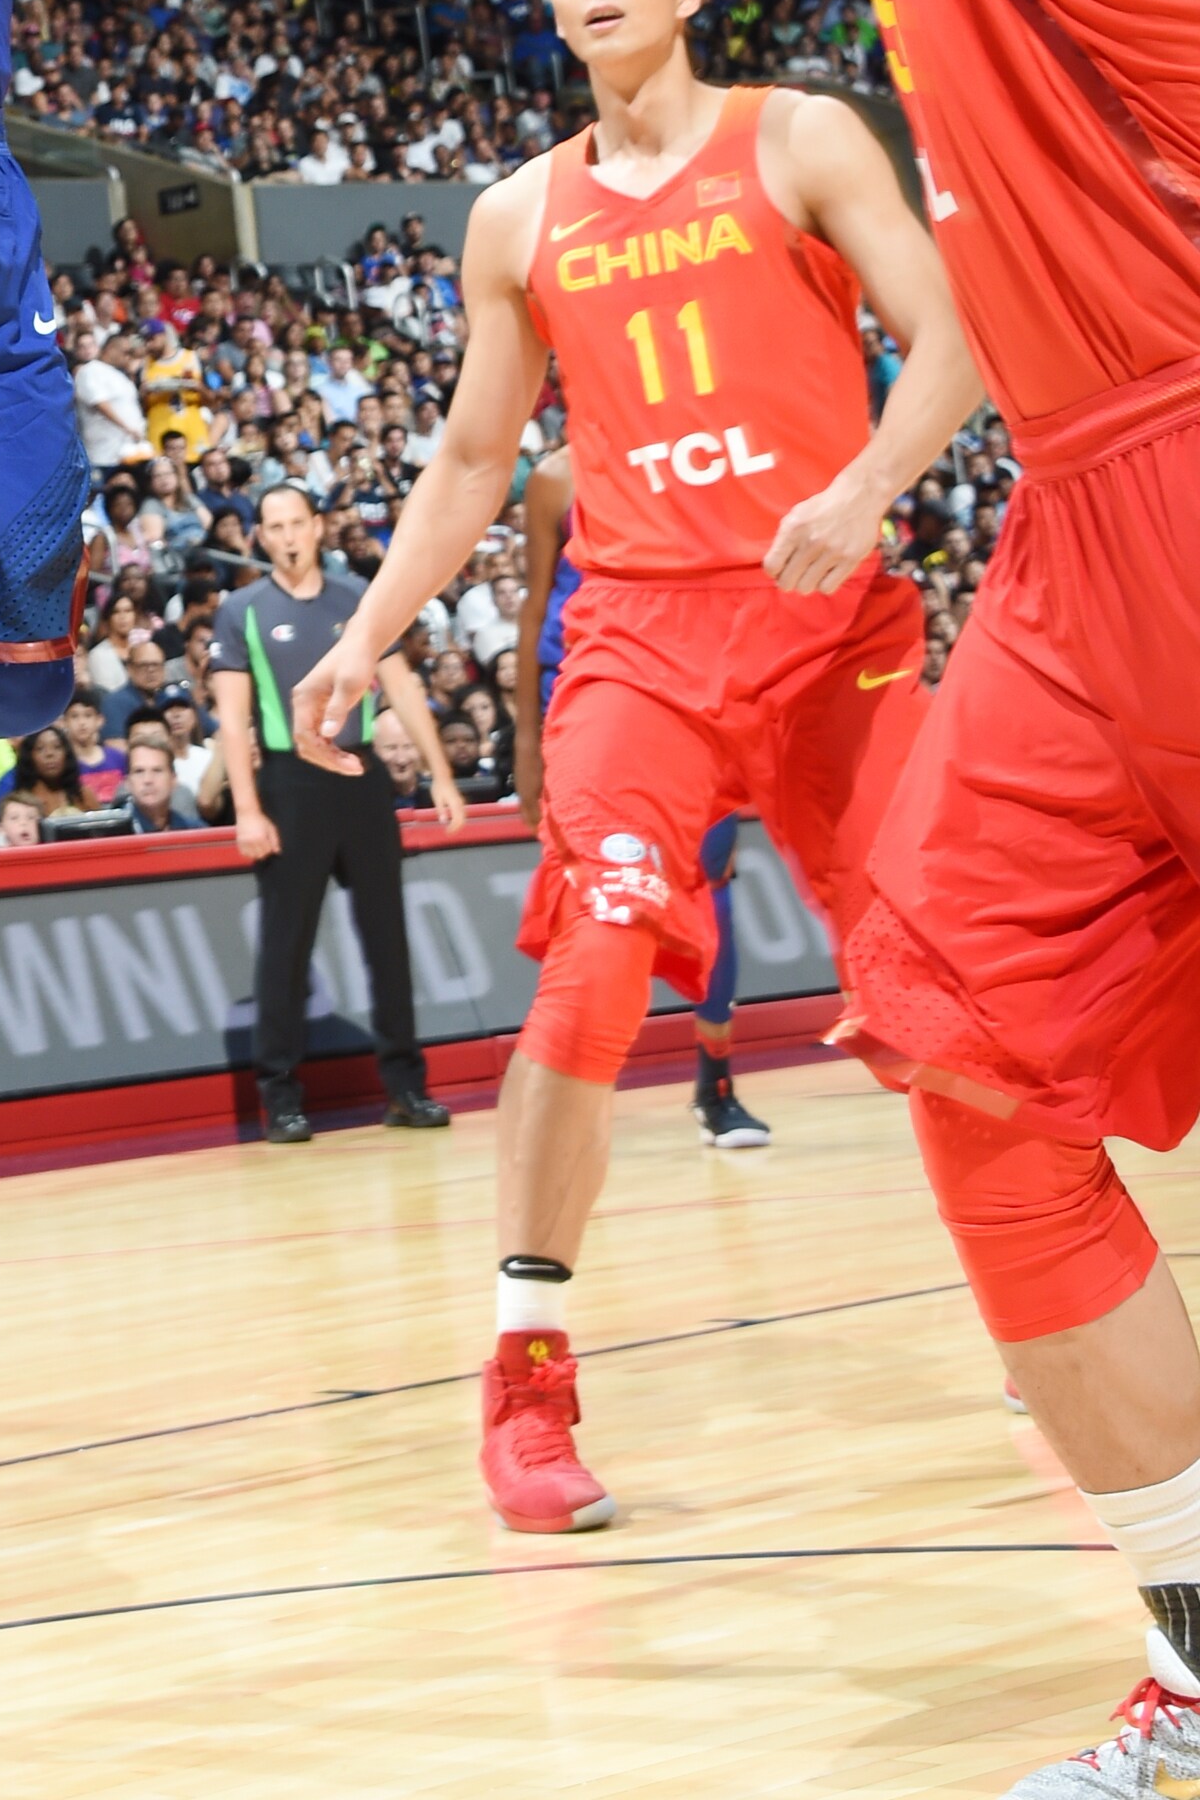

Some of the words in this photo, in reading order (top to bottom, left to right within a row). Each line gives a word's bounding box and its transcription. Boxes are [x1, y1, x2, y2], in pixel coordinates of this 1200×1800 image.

[556, 212, 753, 292] CHINA
[625, 299, 716, 405] 11
[627, 425, 777, 494] TCL
